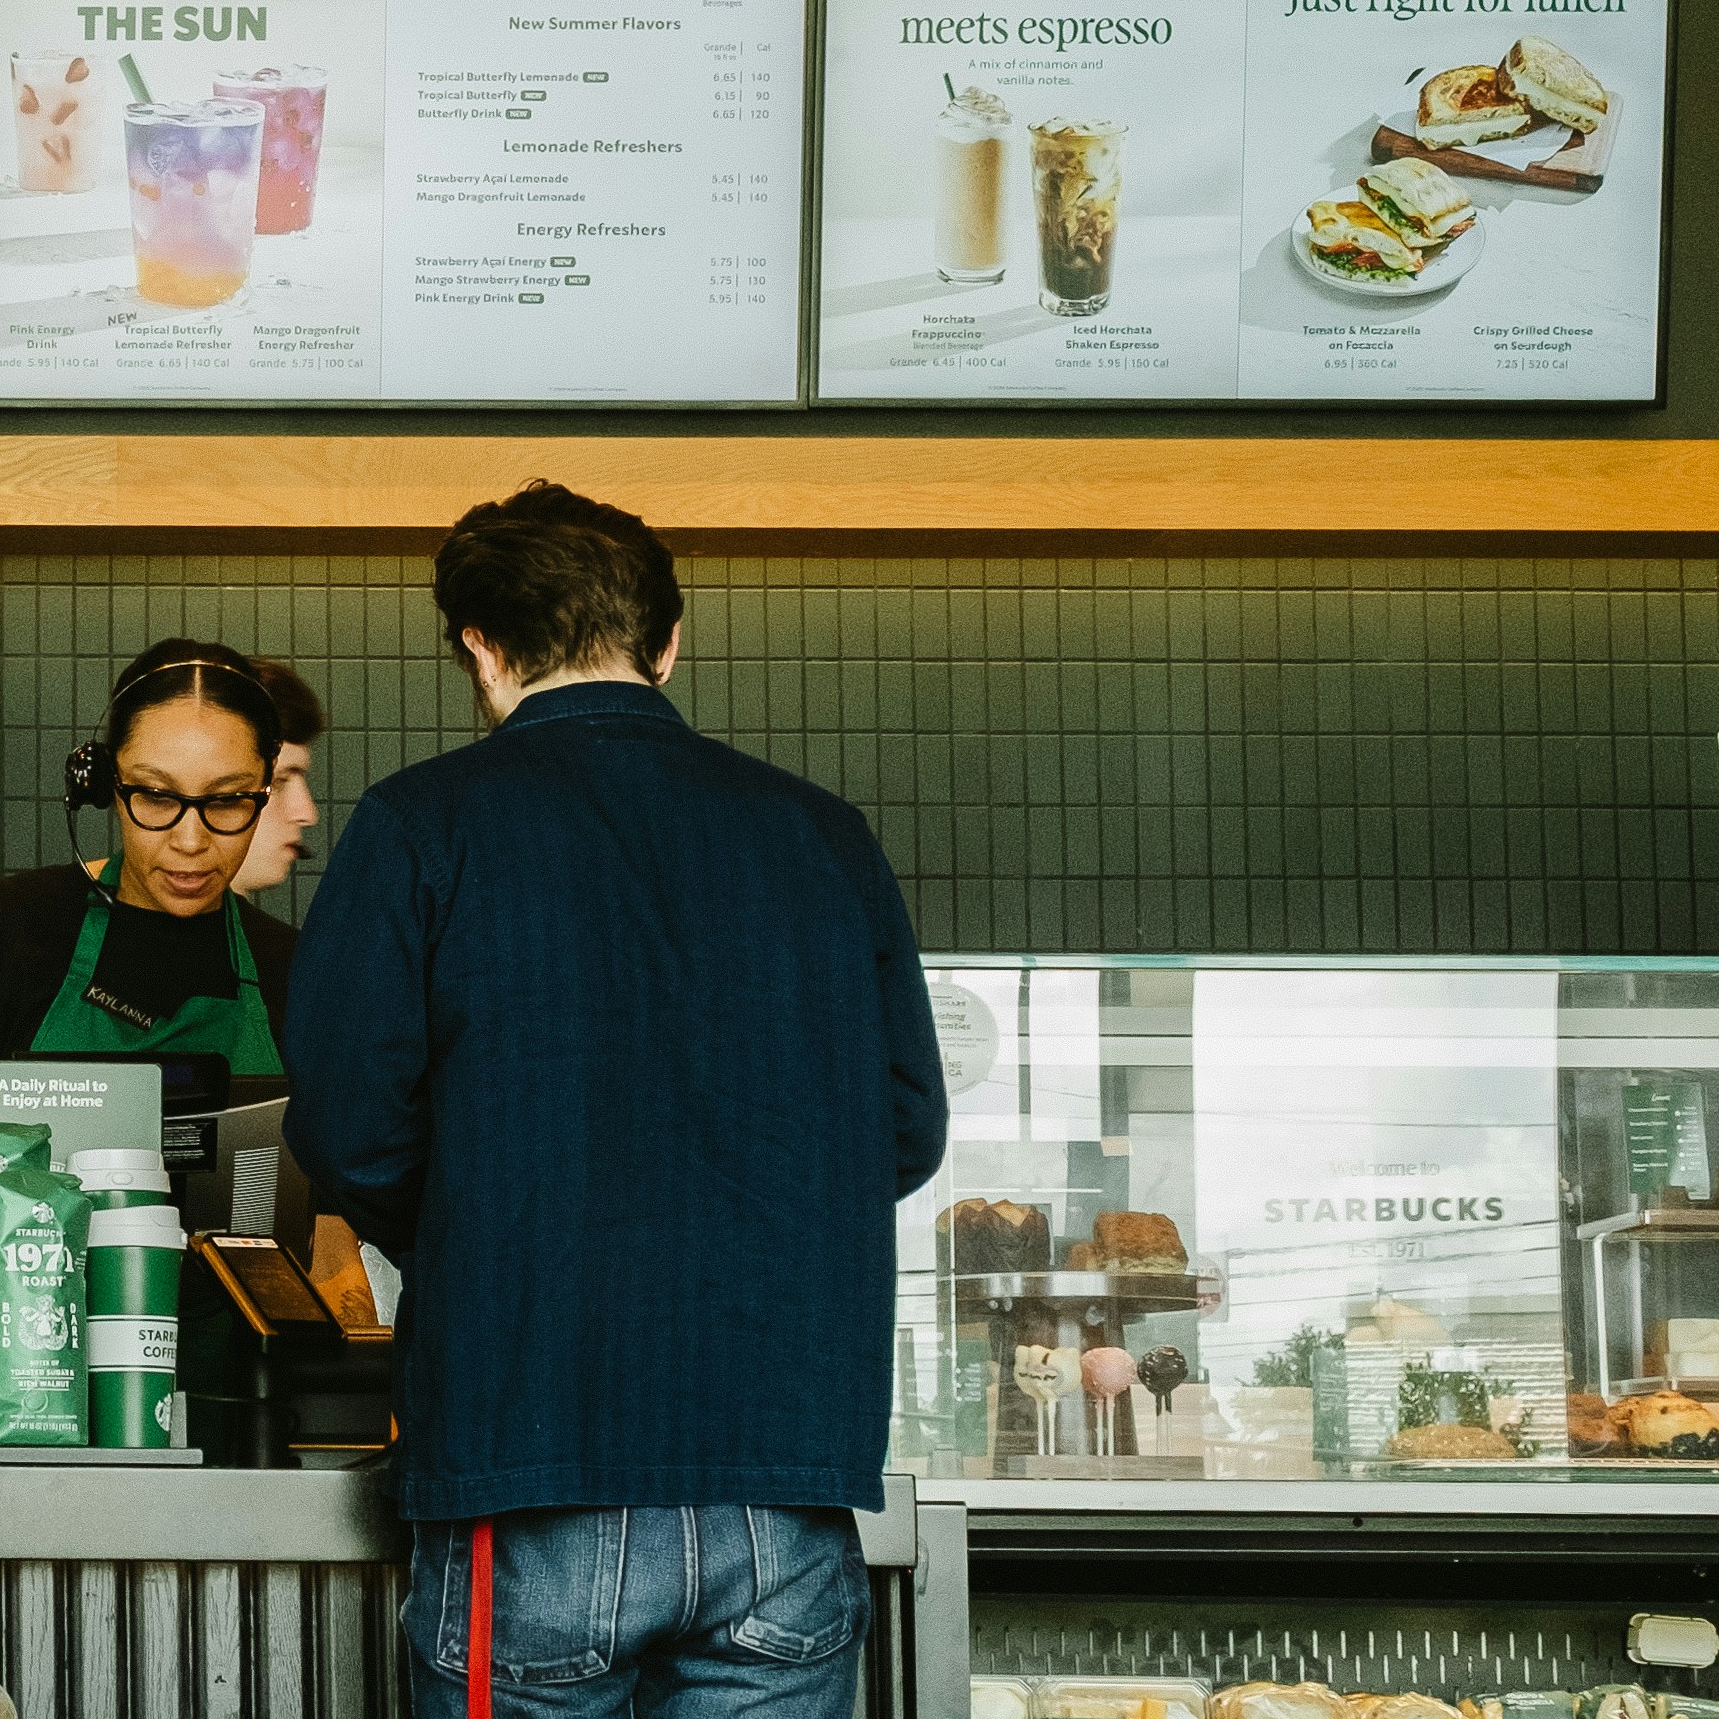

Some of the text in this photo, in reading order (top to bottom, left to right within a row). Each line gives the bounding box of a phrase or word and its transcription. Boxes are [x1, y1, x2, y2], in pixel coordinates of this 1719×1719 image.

[77, 6, 266, 41] THE SUN
[509, 17, 681, 30] New Summer Flavors
[901, 13, 1172, 52] meets espresso
[504, 140, 682, 153] Lemonade Refreshers
[518, 223, 665, 239] Energy Refreshers
[415, 293, 514, 304] Pink Energy Drink
[107, 310, 138, 326] NEW
[1303, 326, 1420, 335] Tomato & Mozzarella
[87, 986, 151, 1027] KAYLANNA
[14, 1079, 46, 1094] Daily
[49, 1079, 89, 1092] Ritual
[92, 1080, 108, 1092] to
[3, 1094, 104, 1109] Enjoy at Home
[1264, 1197, 1503, 1223] STARBUCKS
[1387, 1241, 1425, 1259] 1971
[22, 1276, 63, 1287] ROAST
[2, 1301, 11, 1348] BOLD
